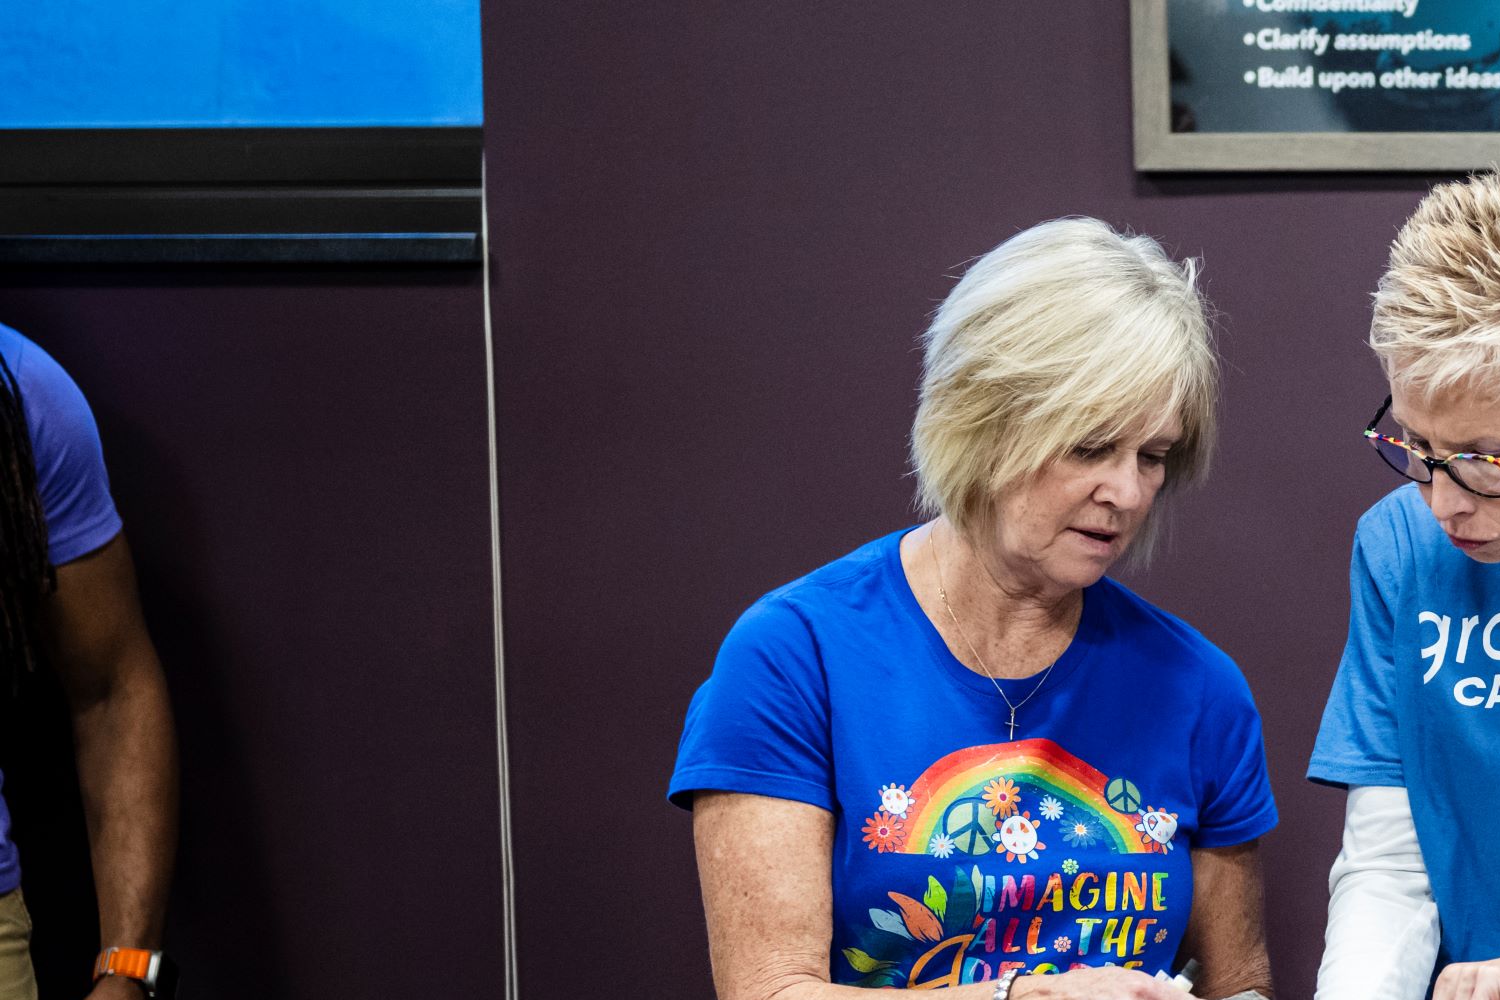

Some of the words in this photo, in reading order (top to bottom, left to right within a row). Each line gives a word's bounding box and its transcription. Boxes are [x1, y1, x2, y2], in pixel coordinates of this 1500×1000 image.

[1256, 27, 1330, 56] Clarify
[1334, 29, 1472, 55] assumptions
[1257, 65, 1314, 88] Build
[1318, 70, 1376, 93] upon
[1380, 66, 1442, 88] other
[982, 871, 1169, 912] IMAGINE
[968, 915, 1047, 954] ALL
[1075, 916, 1158, 958] THE
